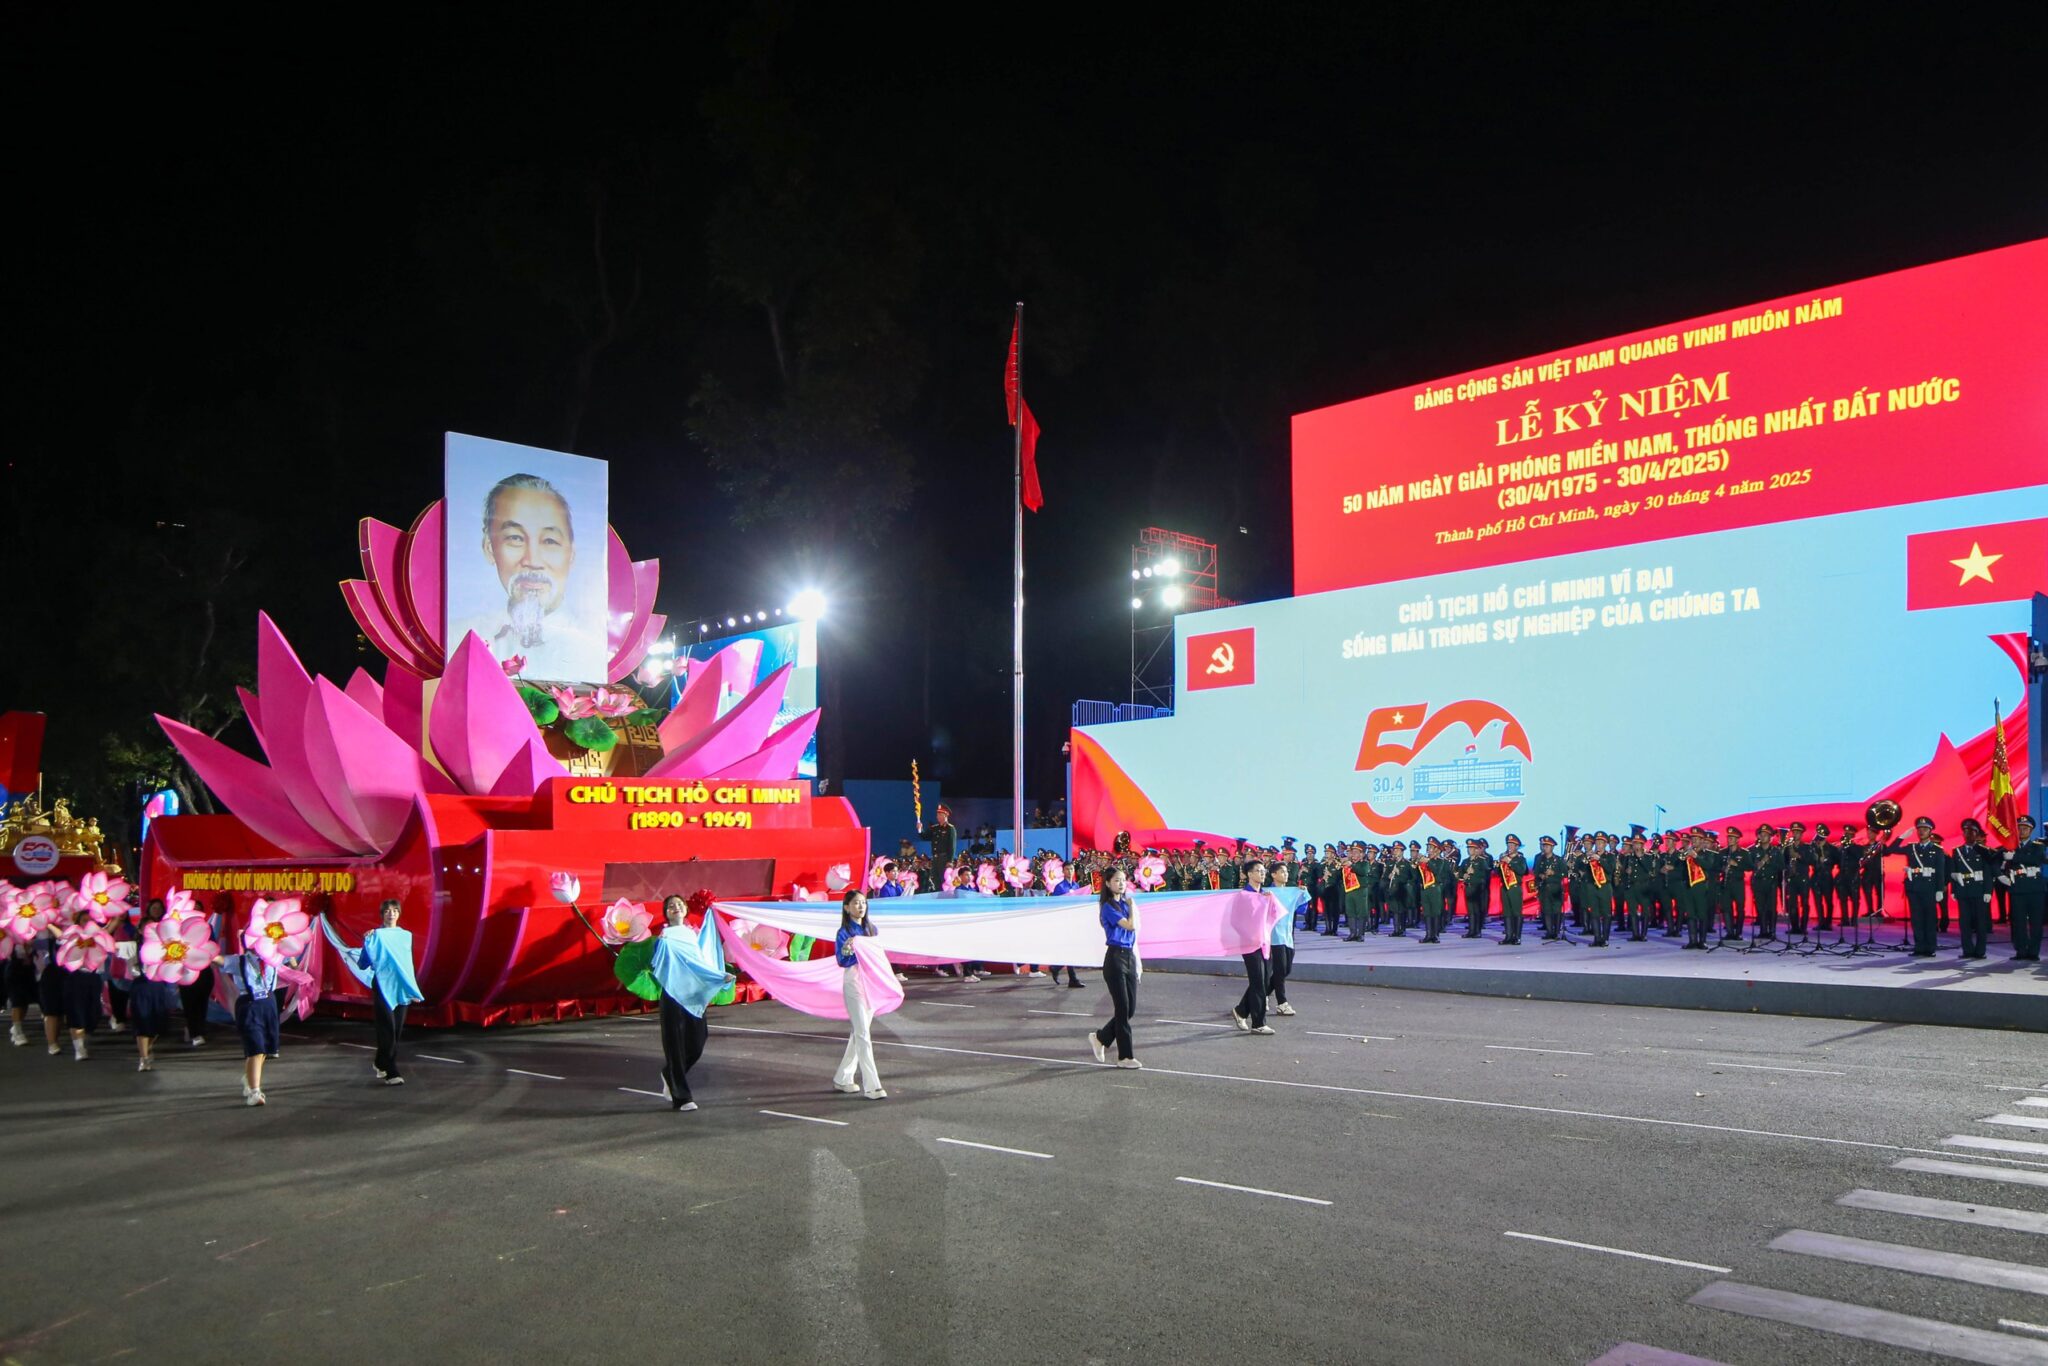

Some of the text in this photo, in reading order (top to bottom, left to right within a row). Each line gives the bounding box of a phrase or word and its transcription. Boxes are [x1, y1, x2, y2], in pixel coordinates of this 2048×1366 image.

[1414, 296, 1843, 411] ĐẢNG CỘNG SẢN VIỆT NAM QUANG VINH MUÔN NĂM
[1495, 371, 1731, 446] LỄ KỶ NIỆM
[1342, 376, 1961, 514] 50 NĂM NGÀY GIẢI PHÓNG MIỀN NAM, THỐNG NHẤT ĐẤT NƯỚC
[1435, 468, 1813, 545] Thành phố Hồ Chí Minh, ngày 30 tháng 4 năm 2025
[1497, 472, 1598, 510] (30/4/1975
[1616, 448, 1730, 488] 30/4/2025)
[1341, 587, 1761, 660] SỐNG MÃI TRONG SỰ NGHIỆP CỦA CHÚNG TA
[1398, 594, 1434, 624] CHỦ
[1438, 594, 1479, 622] TỊCH
[1513, 579, 1546, 609] CHÍ
[1551, 576, 1605, 604] MINH
[1610, 568, 1632, 595] VĨ
[1636, 566, 1674, 594] ĐẠI
[569, 780, 801, 807] CHỦ TỊCH HỒ CHÍ MINH
[1373, 776, 1404, 792] 30.4
[631, 811, 684, 831] (1890
[703, 811, 752, 830] 1969)
